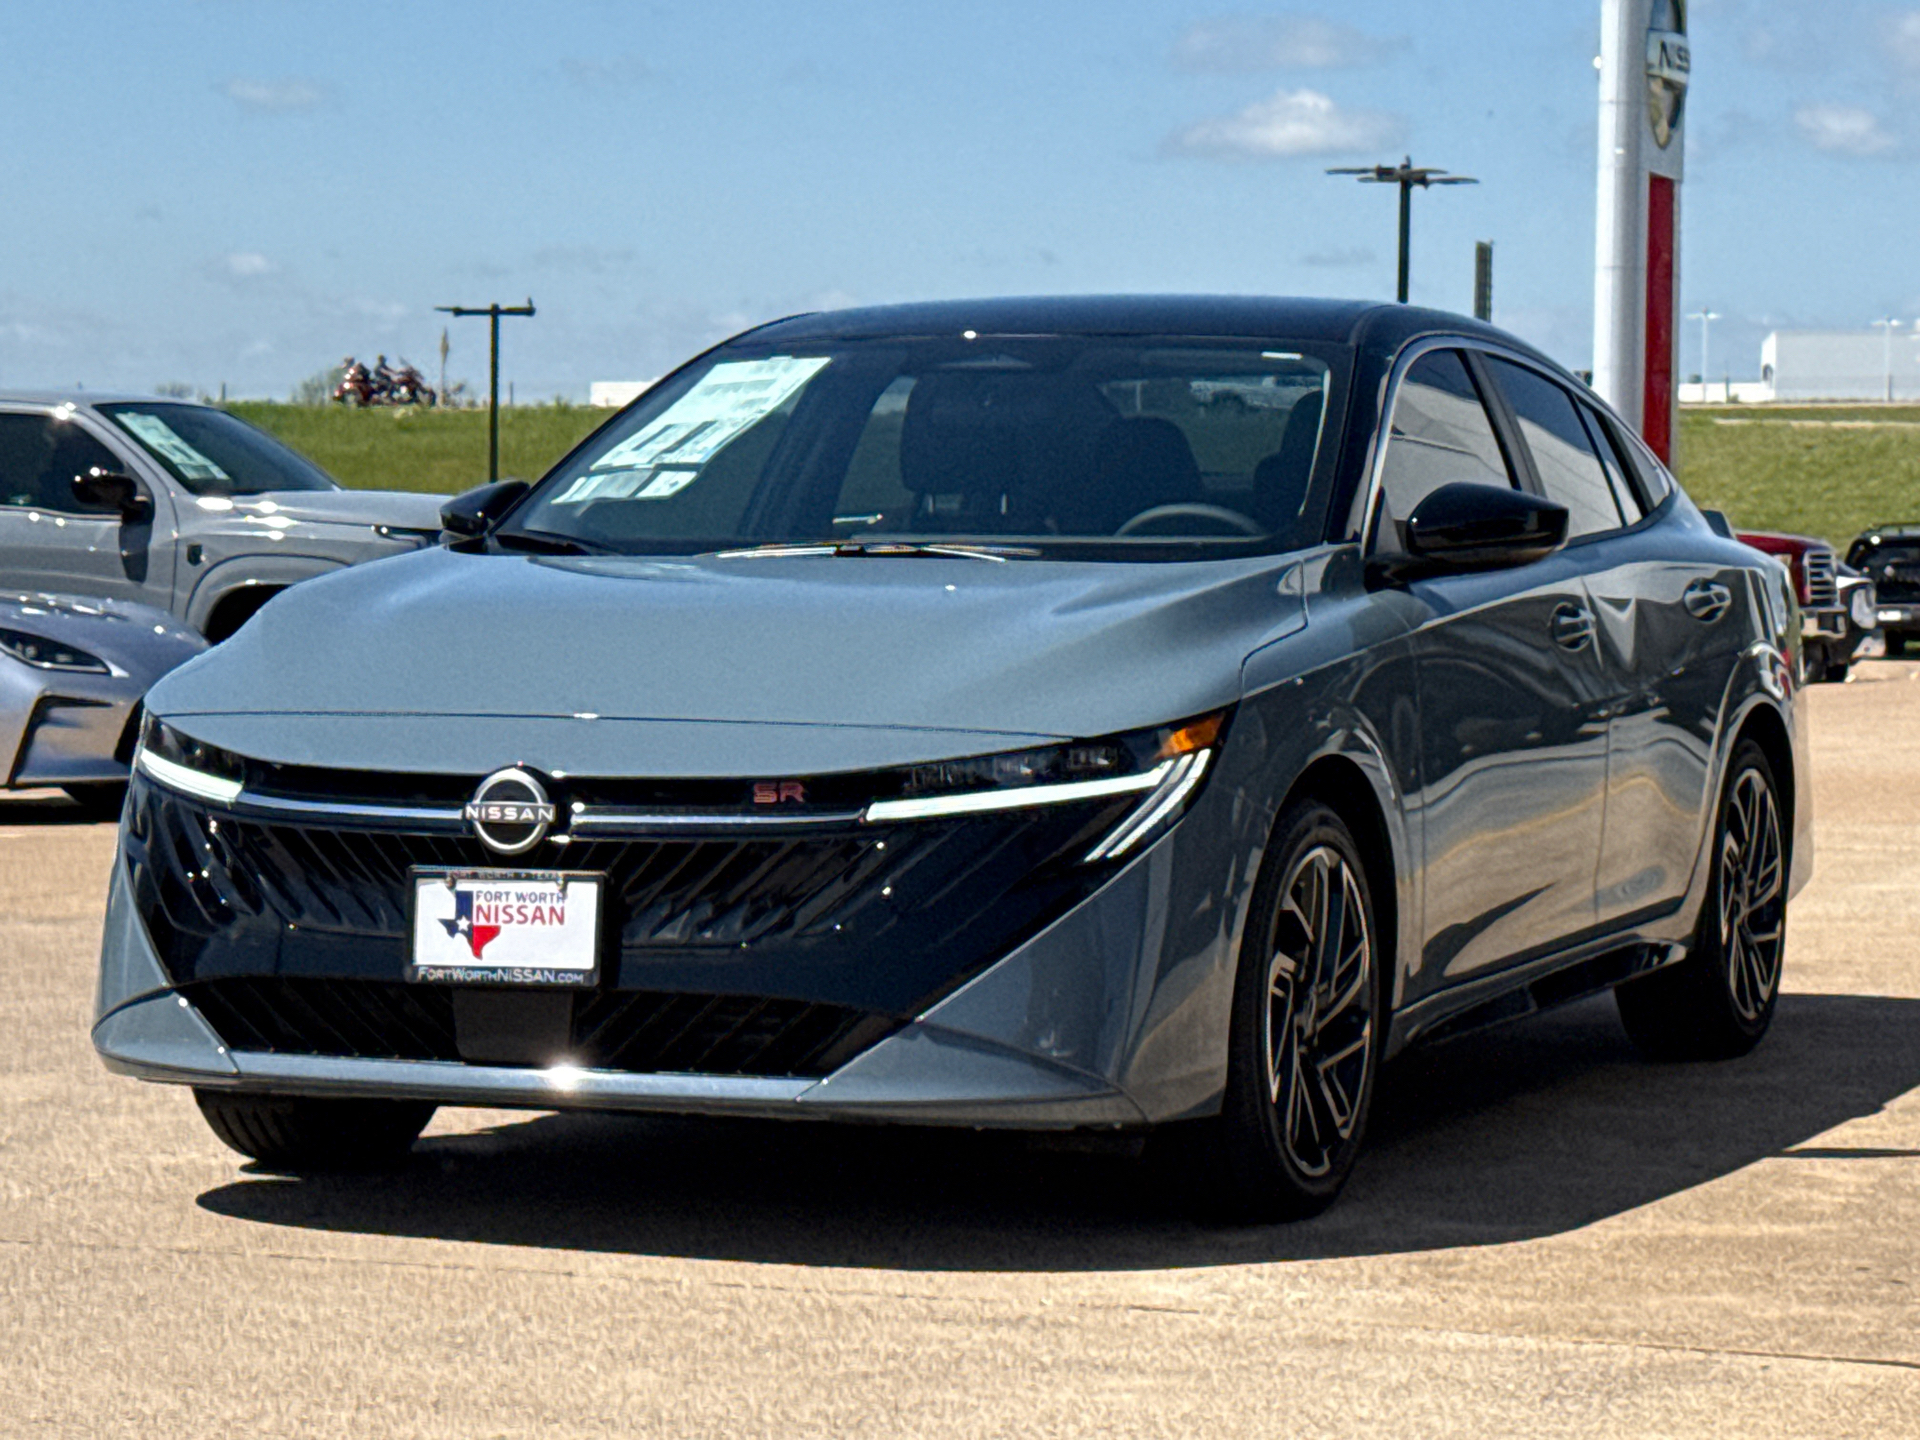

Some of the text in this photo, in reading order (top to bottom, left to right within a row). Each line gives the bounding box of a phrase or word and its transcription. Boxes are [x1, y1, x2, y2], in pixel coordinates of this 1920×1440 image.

[753, 782, 805, 804] SR
[465, 805, 555, 822] NISSAN
[475, 890, 566, 904] FORT WORTH
[475, 904, 565, 926] NISSAN
